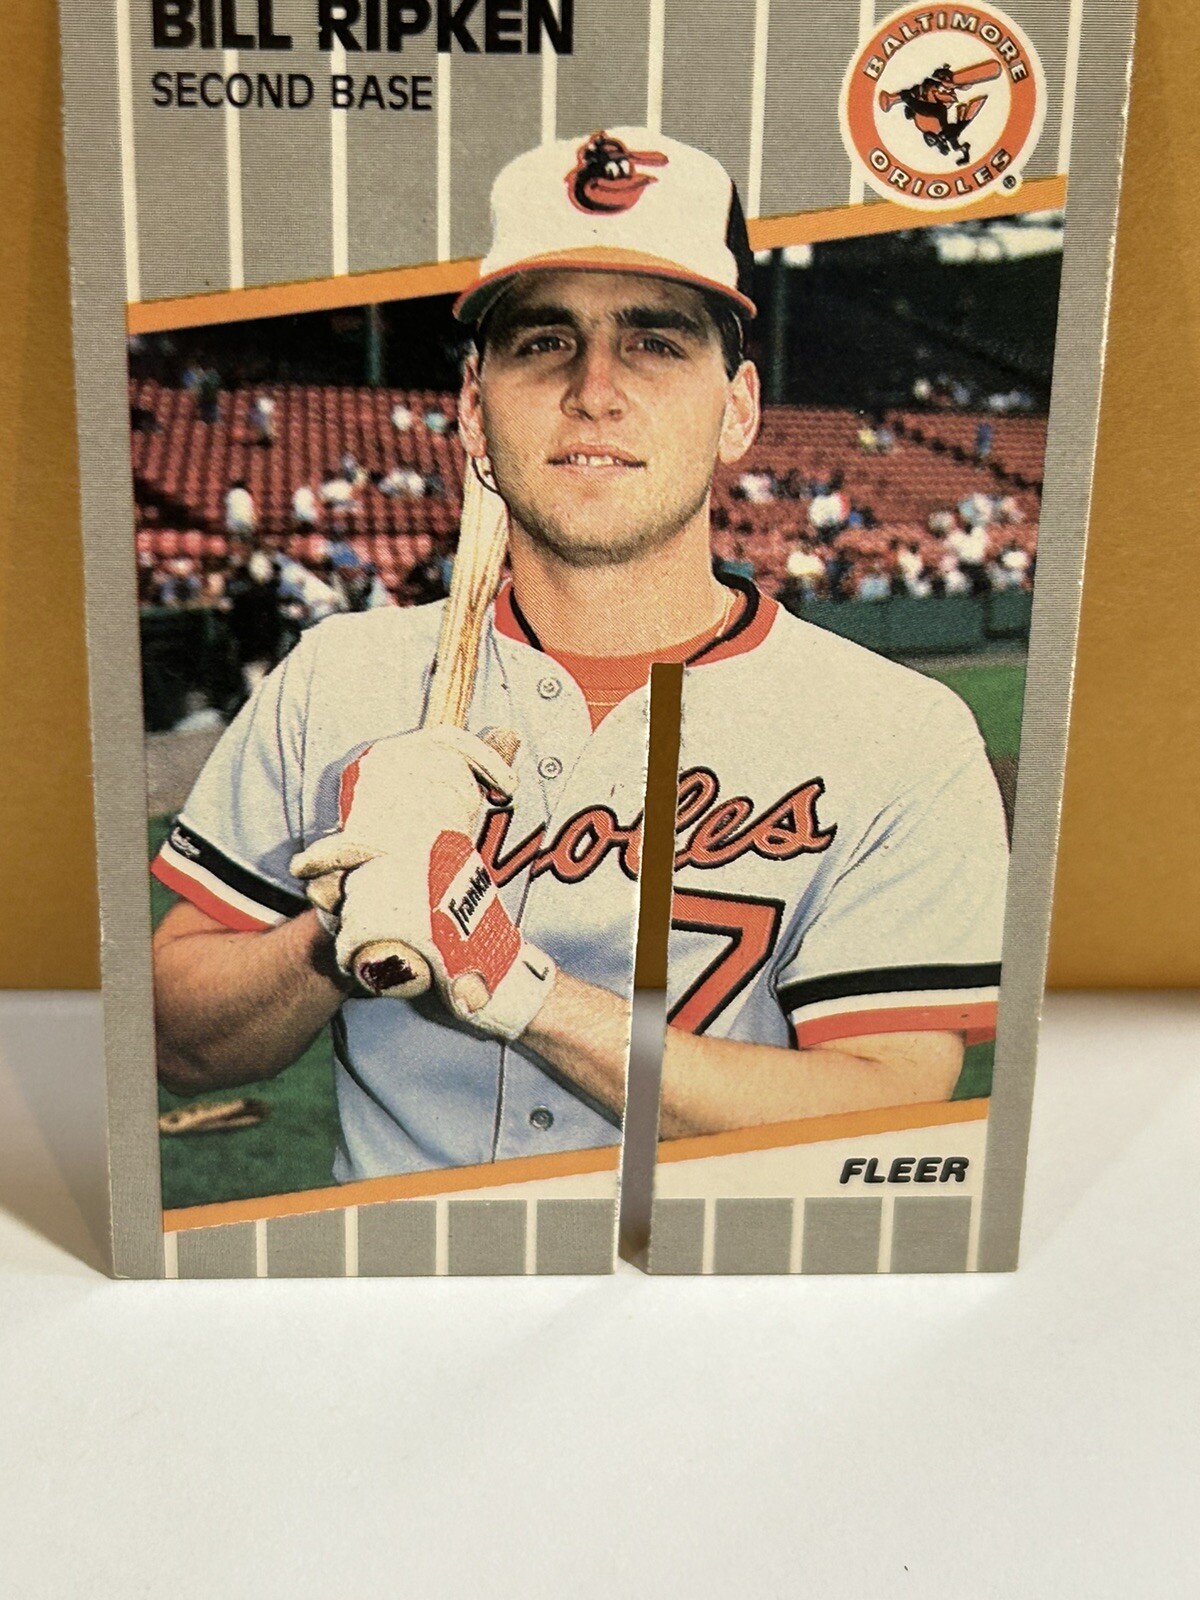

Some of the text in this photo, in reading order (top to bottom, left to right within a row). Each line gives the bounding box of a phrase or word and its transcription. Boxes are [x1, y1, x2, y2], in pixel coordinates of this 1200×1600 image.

[153, 0, 574, 54] BILL RIPKEN
[863, 11, 1029, 83] BALTIMORE
[152, 71, 433, 110] SECOND BASE
[869, 148, 1012, 198] ORIOLES
[668, 885, 786, 1036] 7
[839, 1156, 970, 1184] FLEER
